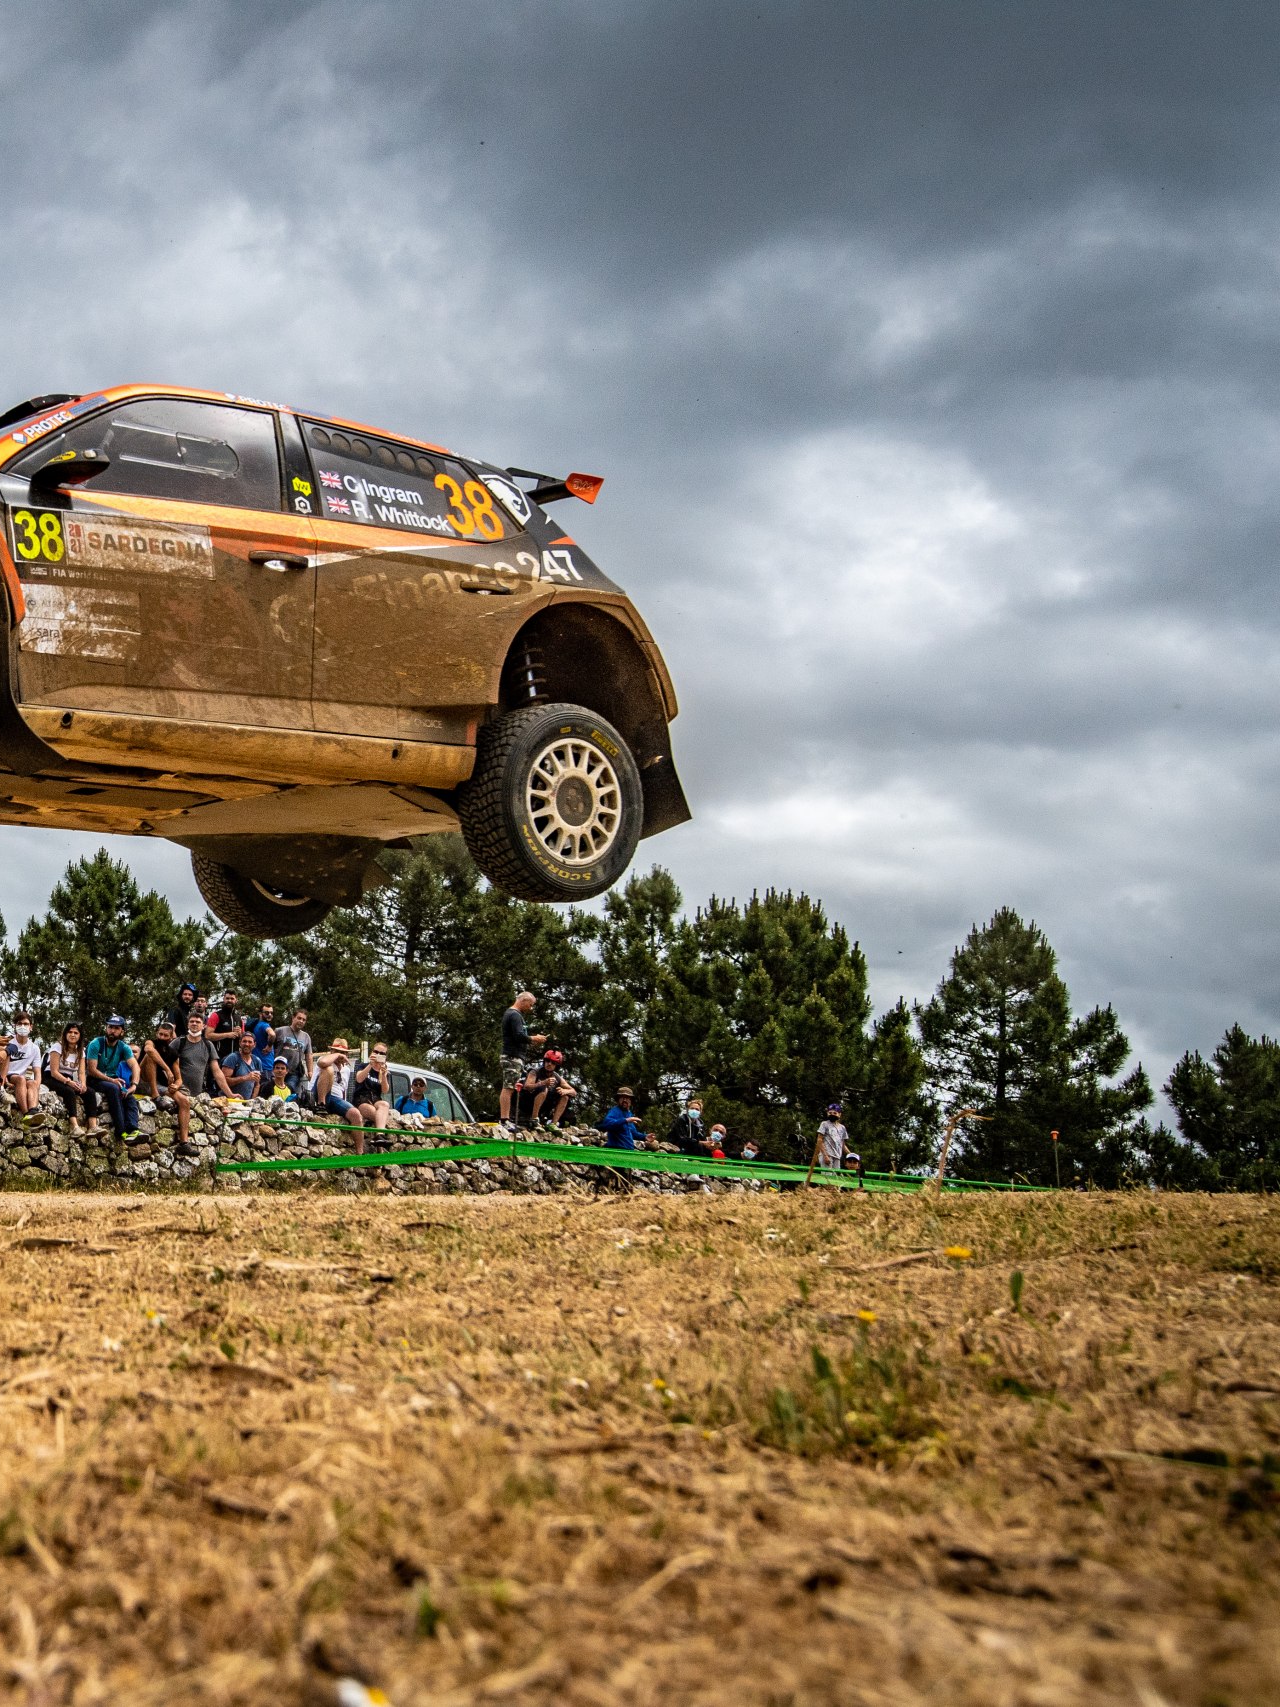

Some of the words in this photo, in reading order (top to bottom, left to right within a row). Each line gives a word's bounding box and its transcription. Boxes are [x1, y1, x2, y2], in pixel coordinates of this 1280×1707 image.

[23, 410, 73, 439] PROTEC
[362, 479, 424, 506] Ingram
[434, 472, 505, 541] 38
[351, 500, 374, 520] R.
[374, 503, 452, 533] Whittock
[14, 510, 65, 562] 38
[87, 531, 206, 559] SARDEGNA
[53, 568, 66, 577] FIA
[516, 550, 584, 583] 247
[37, 626, 61, 638] sara
[590, 729, 620, 758] PIRELLI
[523, 824, 593, 881] SCORPION
